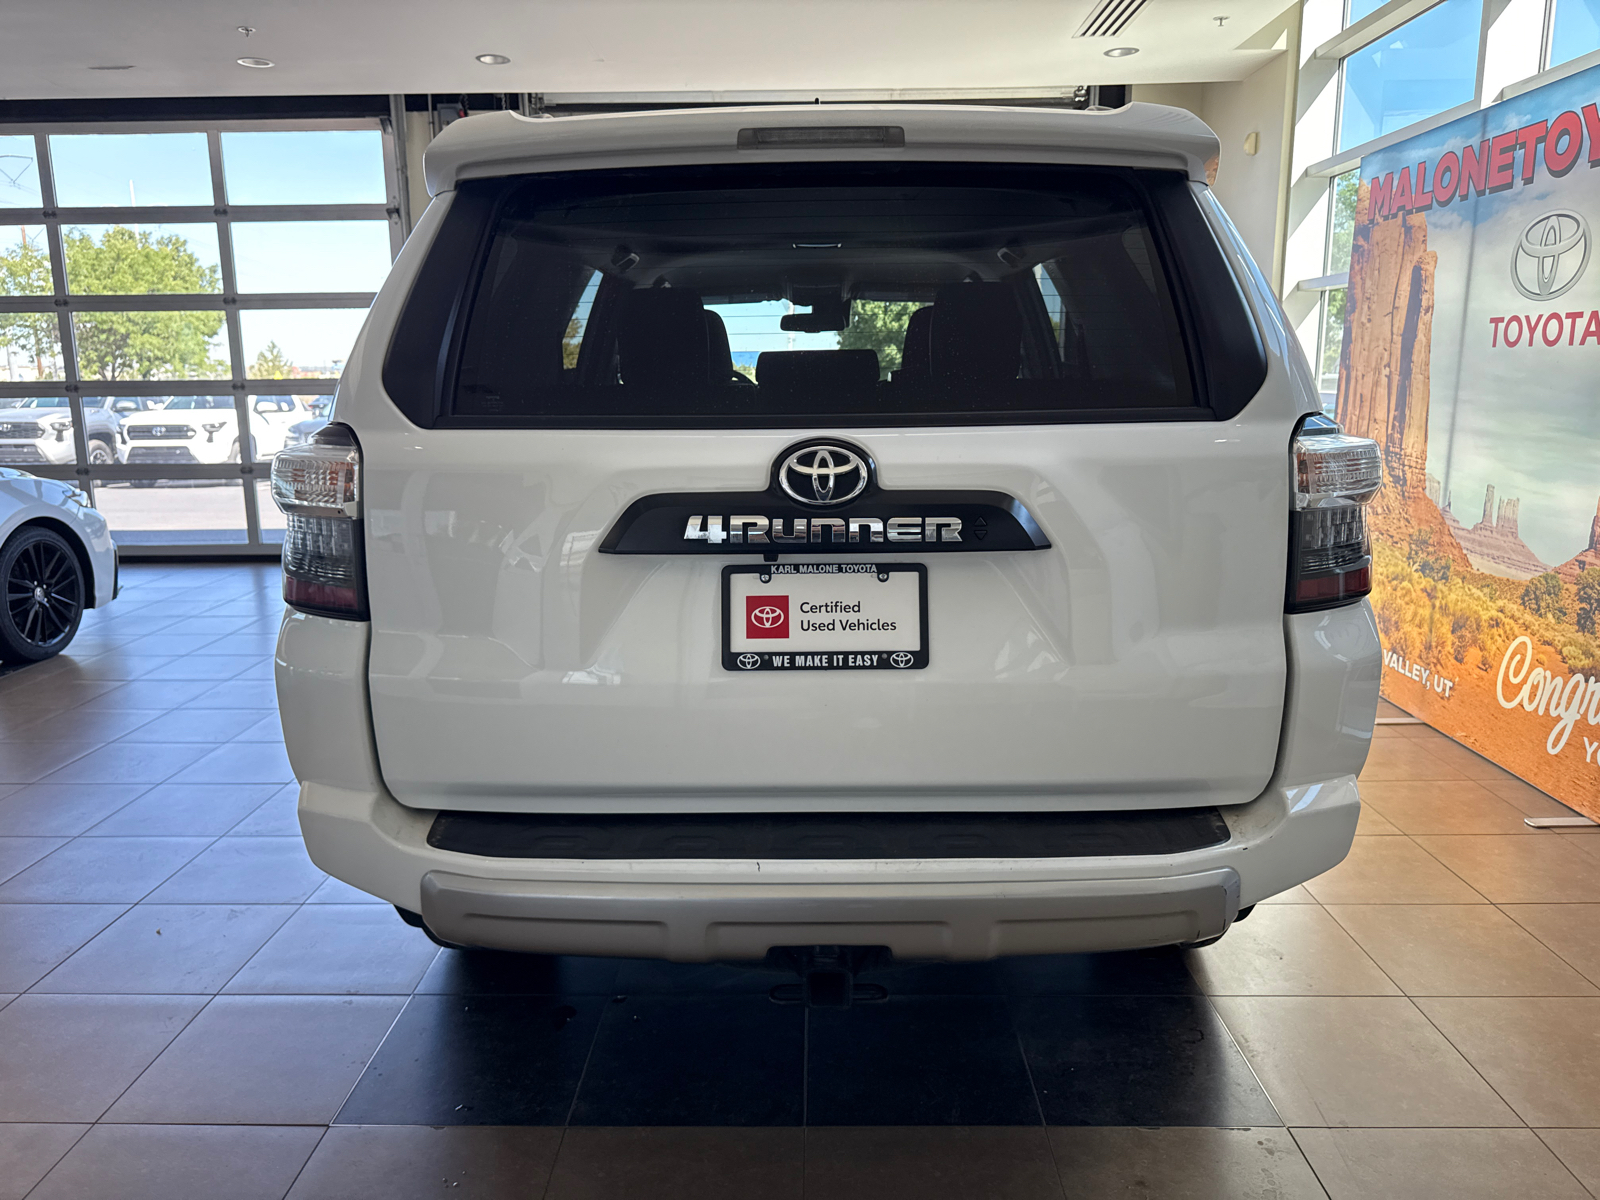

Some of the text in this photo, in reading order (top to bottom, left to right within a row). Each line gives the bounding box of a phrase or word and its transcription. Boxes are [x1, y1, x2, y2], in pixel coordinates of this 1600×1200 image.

[1489, 310, 1600, 348] TOYOTA
[771, 564, 877, 574] KARL MALONE TOYOTA
[800, 601, 861, 614] Certified
[800, 619, 897, 632] Used Vehicles
[772, 654, 879, 667] WE MAKE IT EASY
[1383, 649, 1453, 698] VALLEY, UT
[1583, 736, 1600, 766] Y
